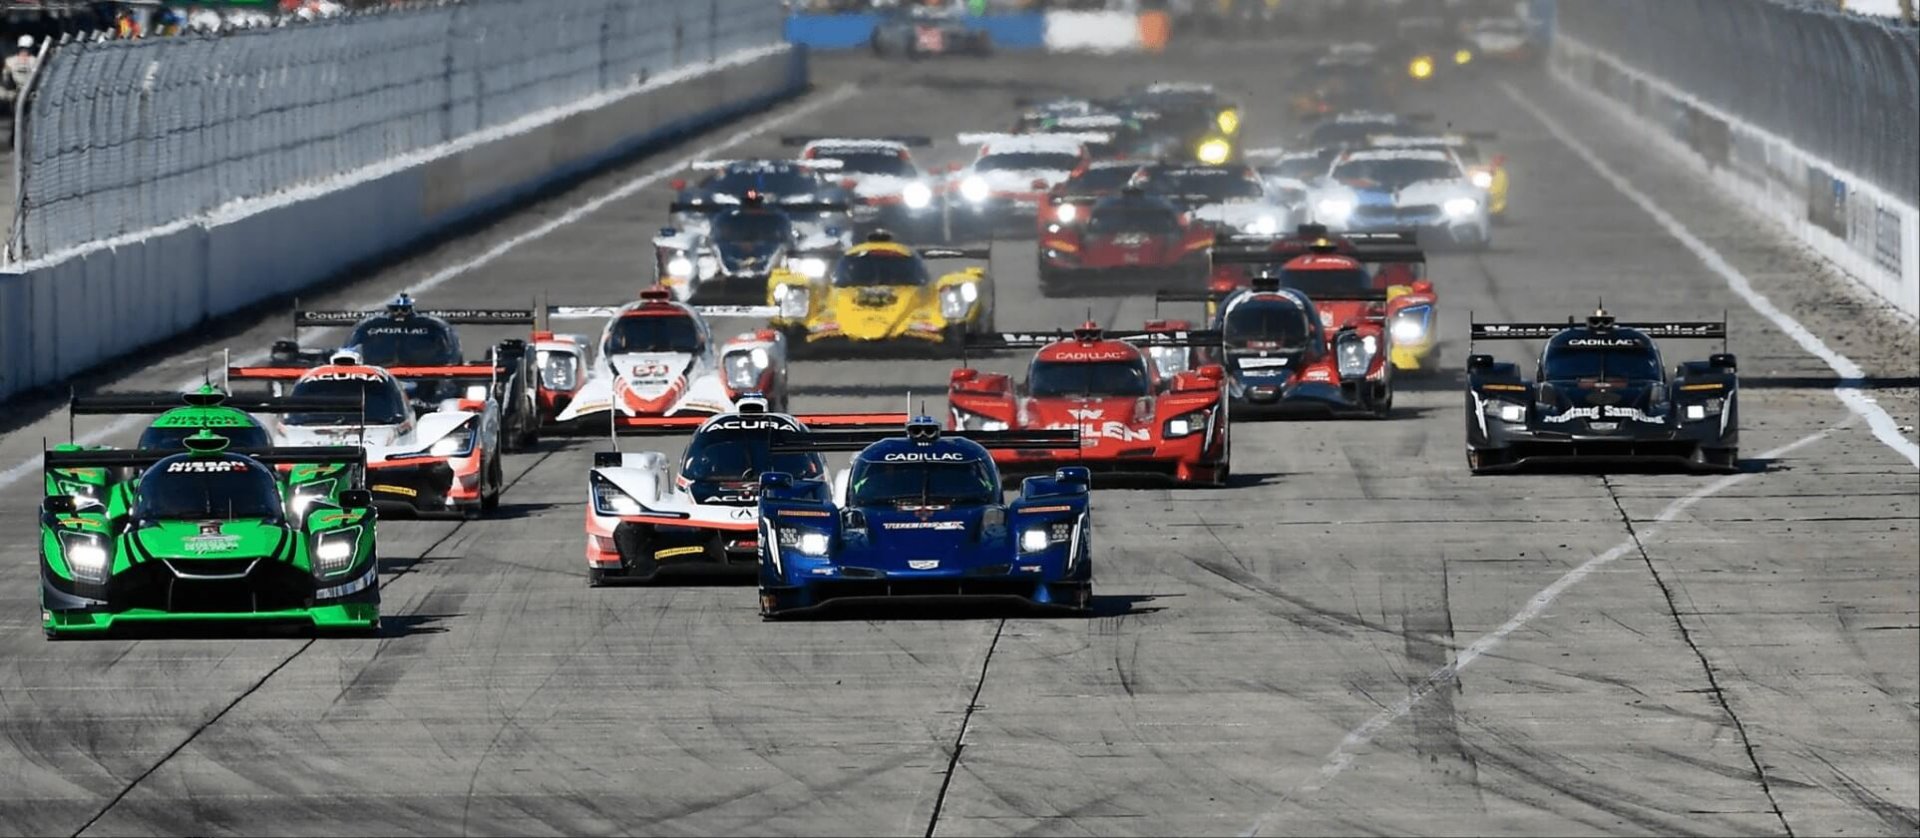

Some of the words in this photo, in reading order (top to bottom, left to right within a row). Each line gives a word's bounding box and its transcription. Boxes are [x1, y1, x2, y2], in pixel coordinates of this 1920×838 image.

[1568, 338, 1632, 346] CADILLAC
[1056, 352, 1121, 360] CADILLAC
[304, 372, 383, 383] ACURA
[706, 421, 797, 432] ACURA
[884, 453, 963, 461] CADILLAC
[704, 495, 760, 503] ACU
